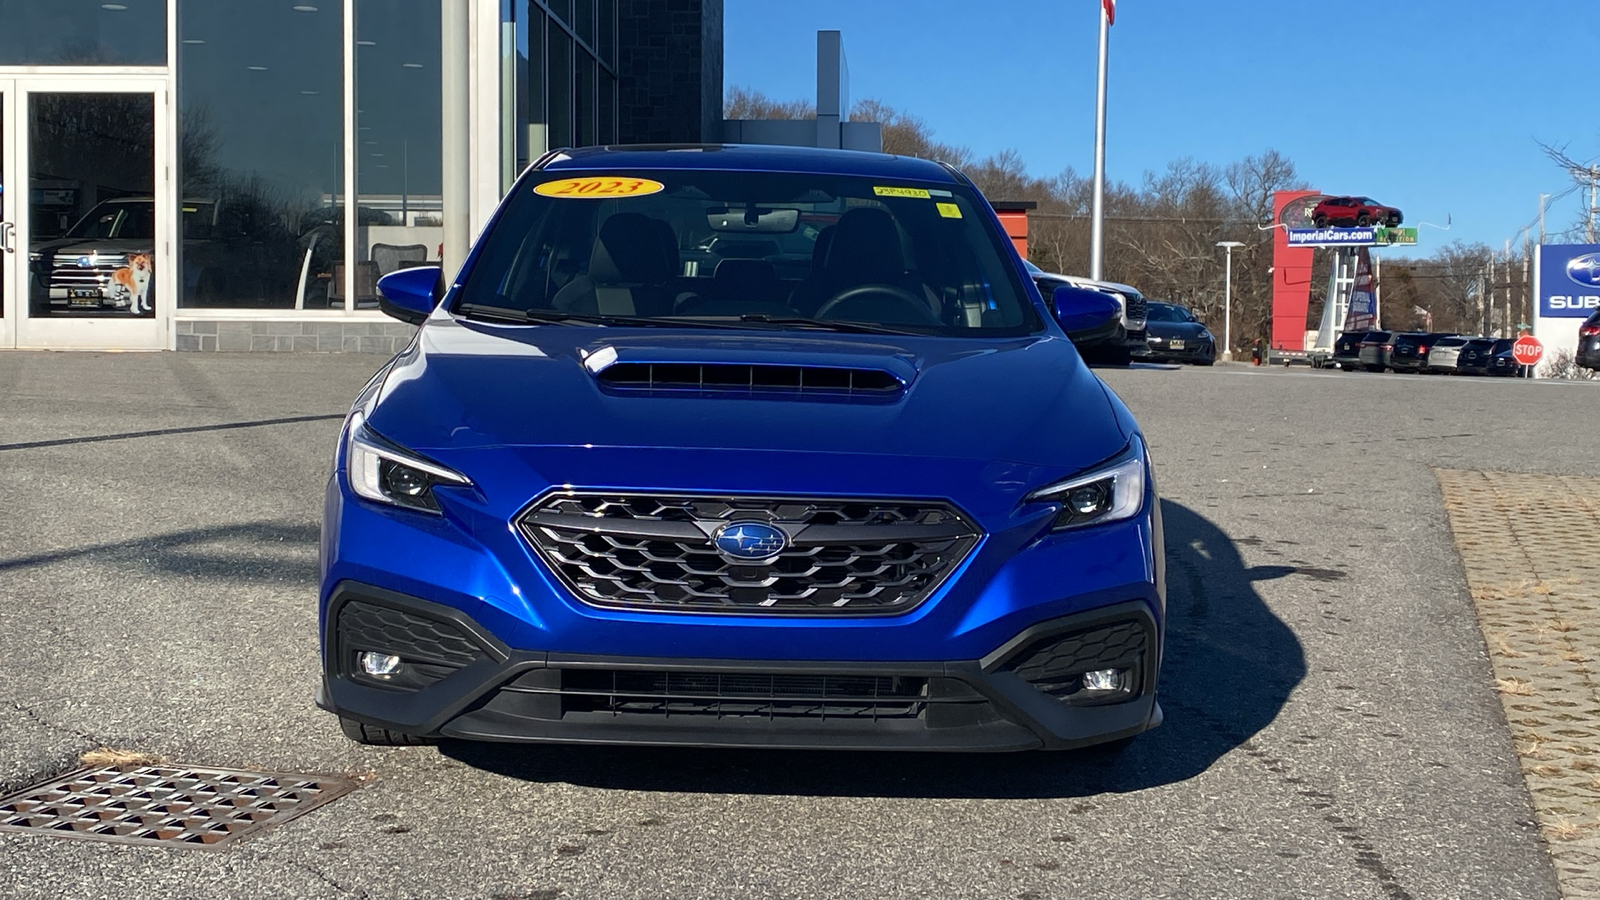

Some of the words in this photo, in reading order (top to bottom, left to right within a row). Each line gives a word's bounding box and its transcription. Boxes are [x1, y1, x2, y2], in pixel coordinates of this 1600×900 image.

[555, 181, 643, 194] 2023
[1290, 231, 1372, 243] ImperialCars.com
[1515, 344, 1542, 356] STOP
